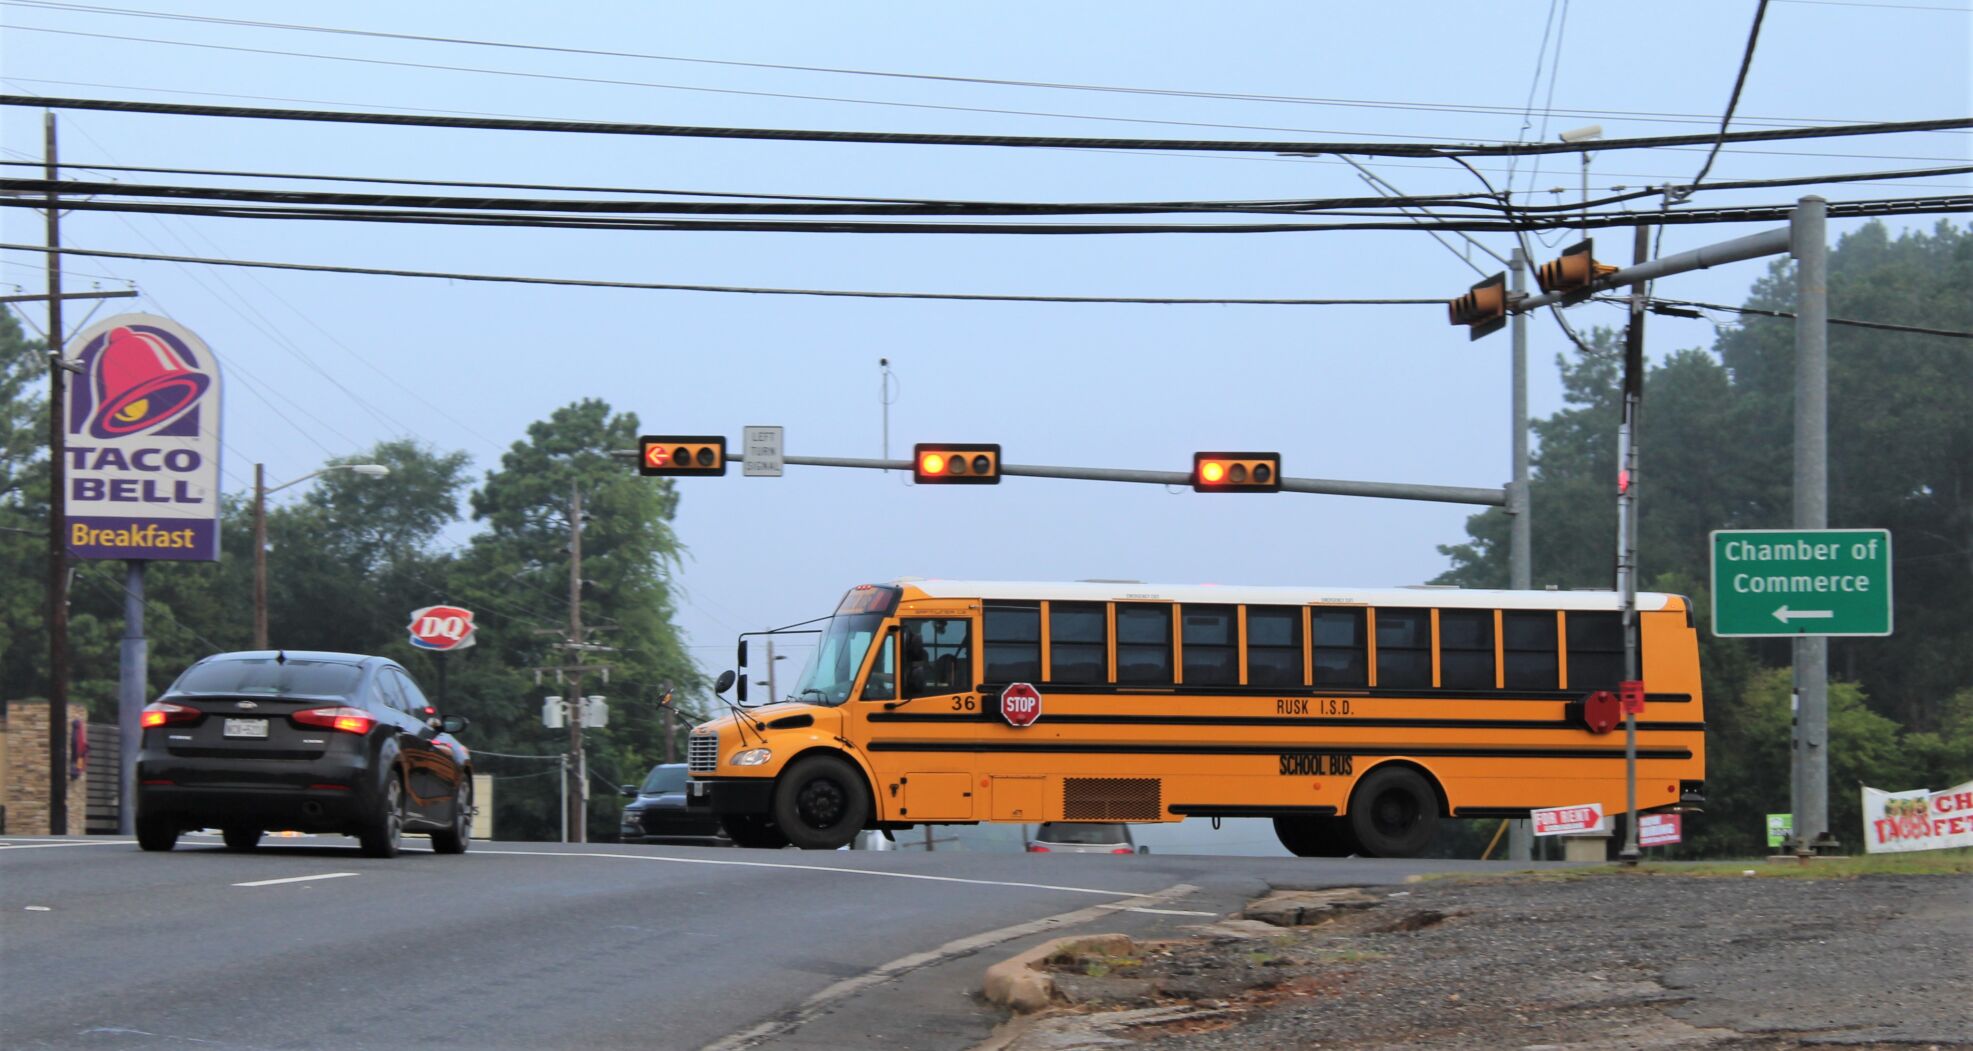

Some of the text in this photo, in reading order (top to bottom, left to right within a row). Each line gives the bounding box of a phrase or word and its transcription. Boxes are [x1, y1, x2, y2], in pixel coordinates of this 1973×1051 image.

[751, 431, 777, 442] LEFT
[65, 447, 202, 472] TACO
[750, 446, 777, 456] TURN
[747, 461, 781, 471] SIGNAL
[72, 478, 203, 504] BELL
[72, 523, 195, 548] Breakfast
[1725, 539, 1878, 561] Chamber of
[1733, 573, 1870, 593] Commerce
[420, 616, 464, 640] DQ
[951, 696, 975, 711] 36
[1006, 696, 1036, 713] STOP
[1277, 699, 1354, 715] RUSK I.S.D.
[1280, 754, 1353, 776] SCHOOL BUS
[1536, 808, 1591, 826] FOR RENT
[1873, 813, 1931, 844] TACOS
